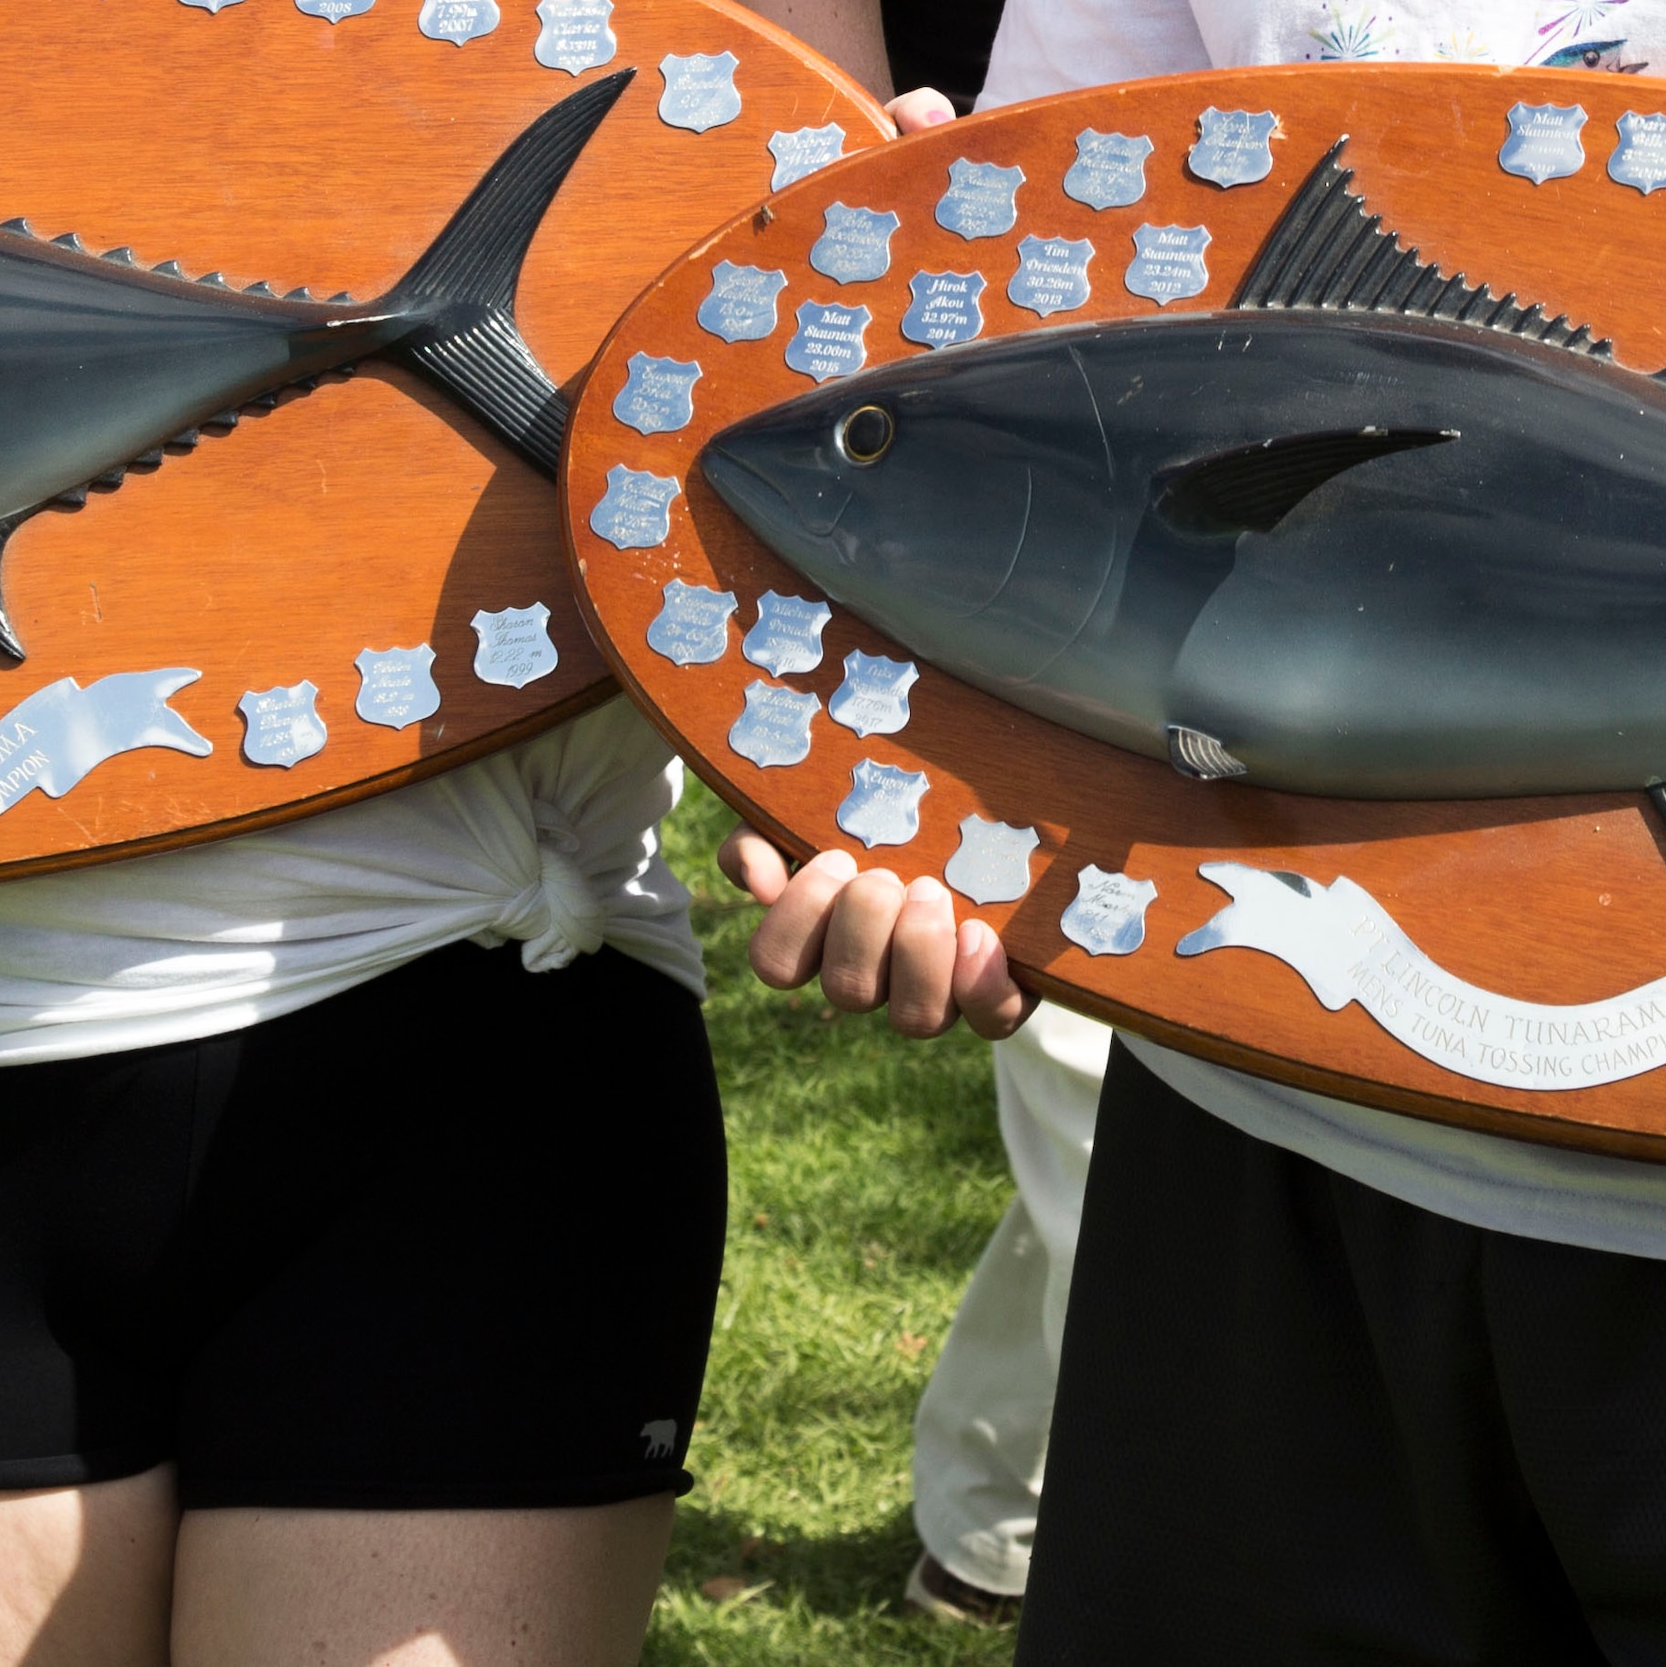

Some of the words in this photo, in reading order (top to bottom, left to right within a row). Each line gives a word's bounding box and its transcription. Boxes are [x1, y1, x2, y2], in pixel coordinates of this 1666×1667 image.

[317, 2, 352, 13] 2008
[1532, 112, 1563, 126] Matt
[1158, 232, 1188, 246] Matt
[1044, 244, 1070, 258] Tim
[1141, 246, 1201, 262] Staunton
[1143, 263, 1192, 278] 23.24m
[1149, 281, 1182, 294] 2012
[924, 296, 965, 311] Akou
[1032, 293, 1063, 306] 2013
[821, 310, 852, 326] Matt
[920, 312, 968, 325] 32.97m
[803, 325, 862, 343] Staunton
[926, 328, 957, 340] 2014
[506, 662, 534, 679] 1999
[1349, 913, 1390, 954] PT
[1381, 949, 1491, 1033] LINCOLN
[1347, 959, 1404, 1019] MENS
[1410, 1012, 1467, 1059] TUNA
[1478, 1042, 1573, 1078] TOSSING
